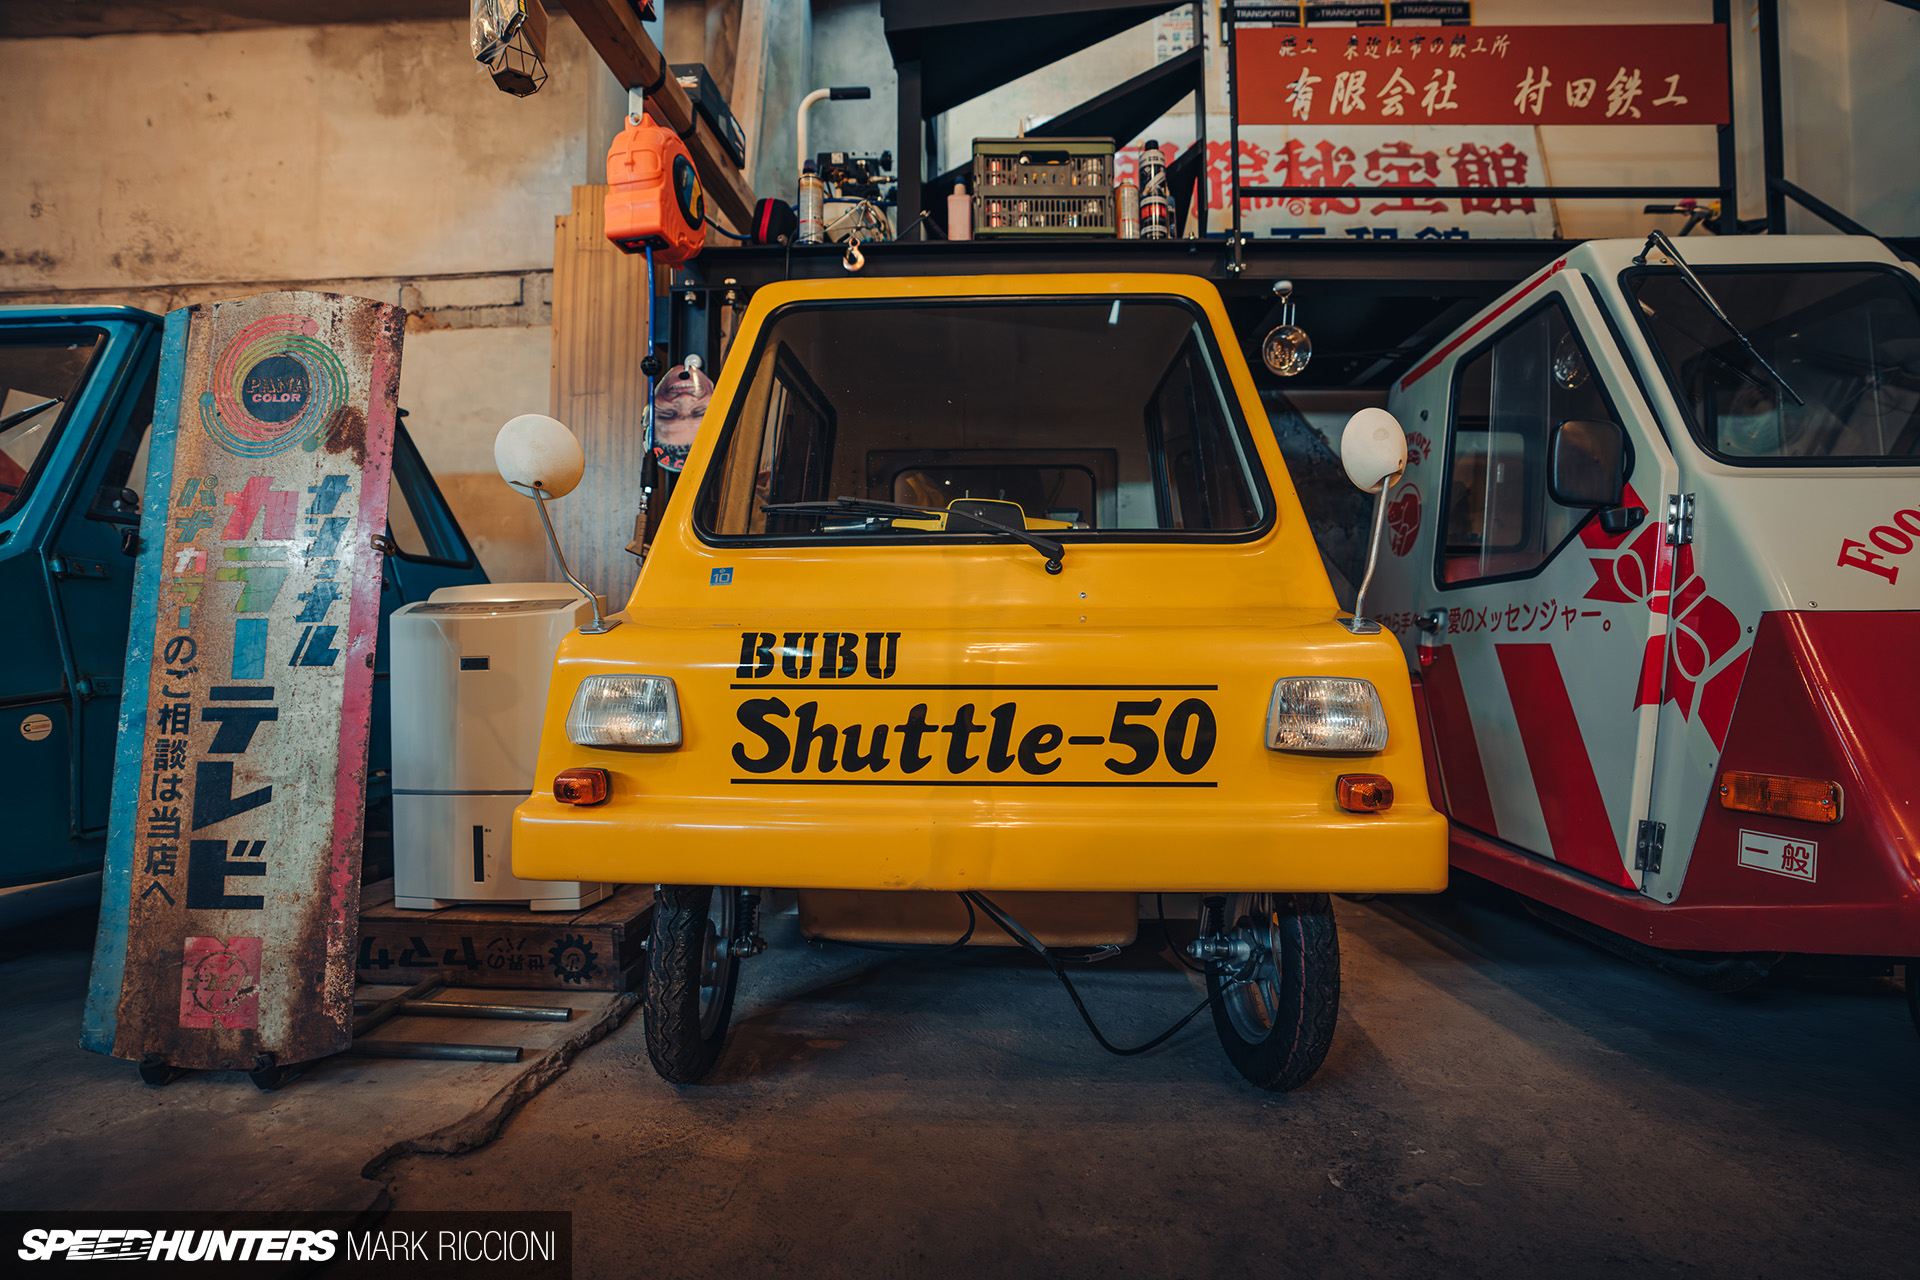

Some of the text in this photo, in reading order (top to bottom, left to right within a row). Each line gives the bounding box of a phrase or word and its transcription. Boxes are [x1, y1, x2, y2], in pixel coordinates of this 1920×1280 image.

[1284, 65, 1689, 121] 有限会社 村田鉄工
[245, 376, 308, 393] PANA
[252, 392, 302, 403] COLOR
[288, 474, 353, 666] ナショナル
[1837, 504, 1920, 586] Foo
[1448, 598, 1612, 635] 愛のメッセンジャー。
[735, 631, 902, 680] BUBU
[186, 476, 299, 910] カラーテレビ
[731, 696, 1218, 776] Shuttle-50
[1744, 843, 1810, 875] 一般
